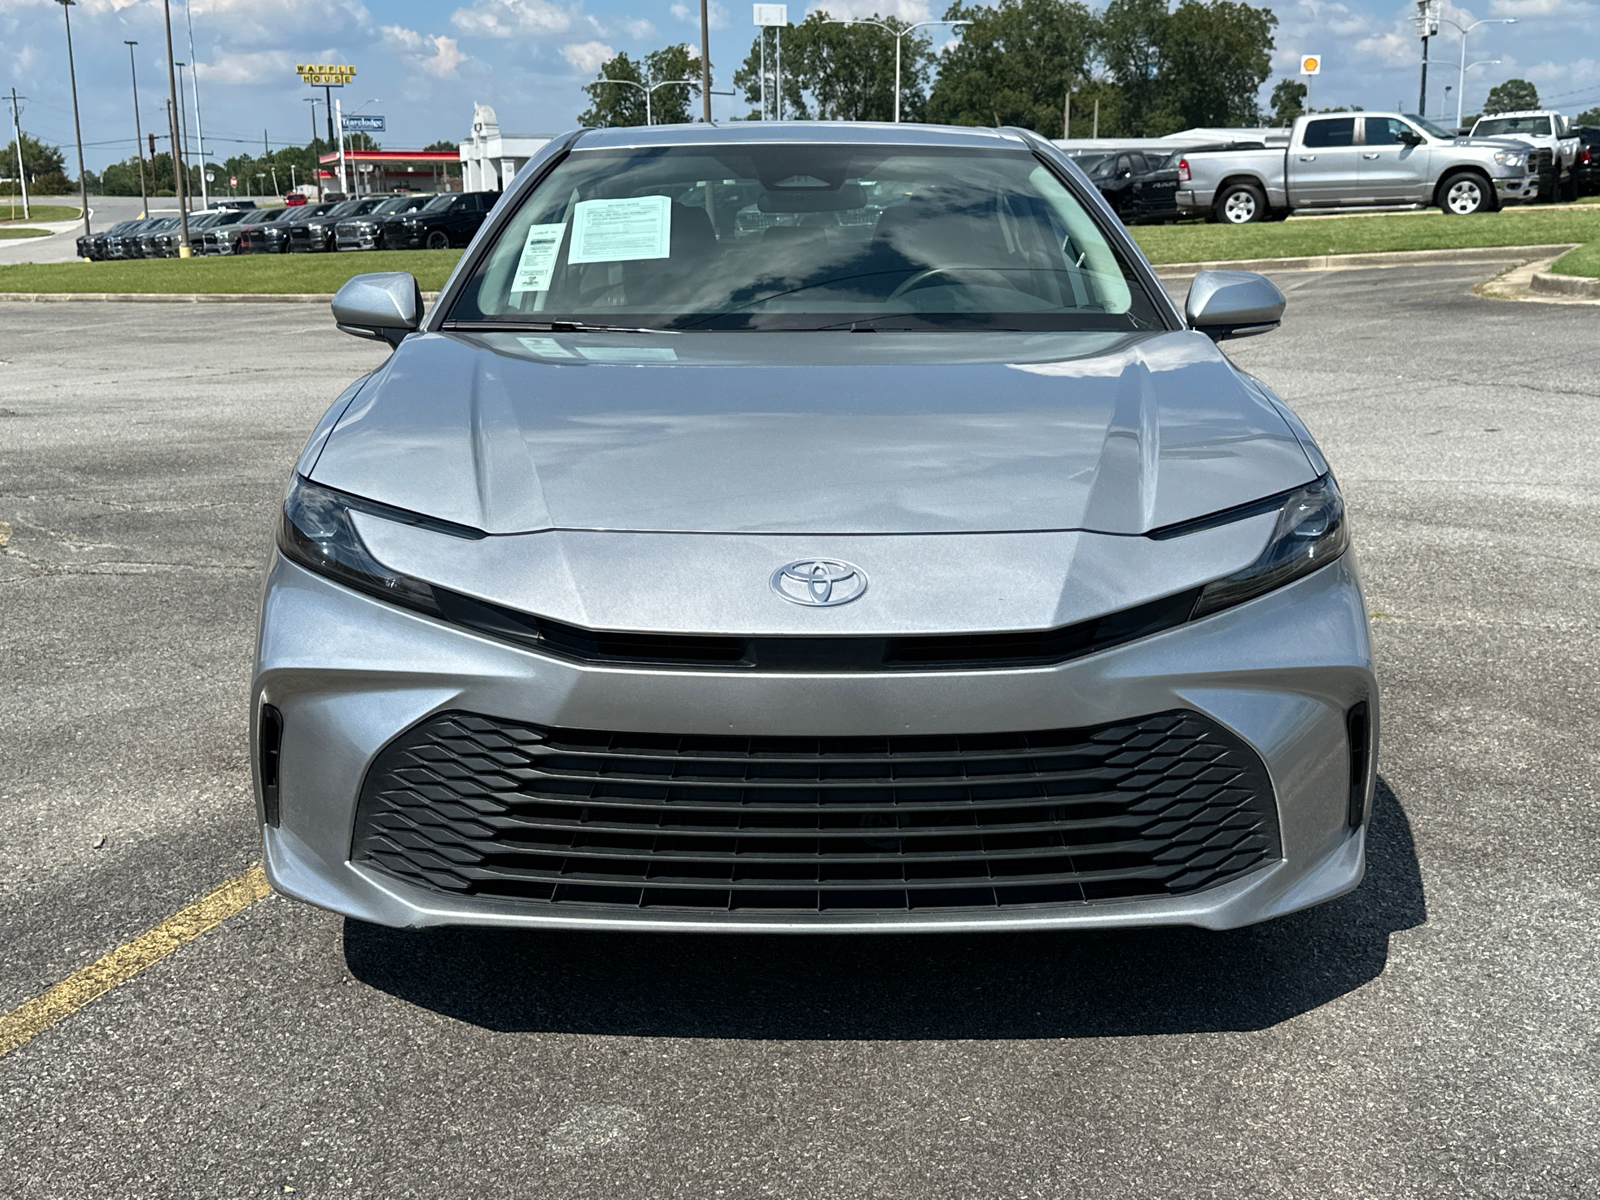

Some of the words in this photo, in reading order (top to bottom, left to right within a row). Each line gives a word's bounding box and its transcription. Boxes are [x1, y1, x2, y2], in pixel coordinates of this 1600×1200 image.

[296, 65, 356, 74] WAFFLE
[303, 75, 352, 83] HOUSE
[342, 117, 383, 128] Travelodge
